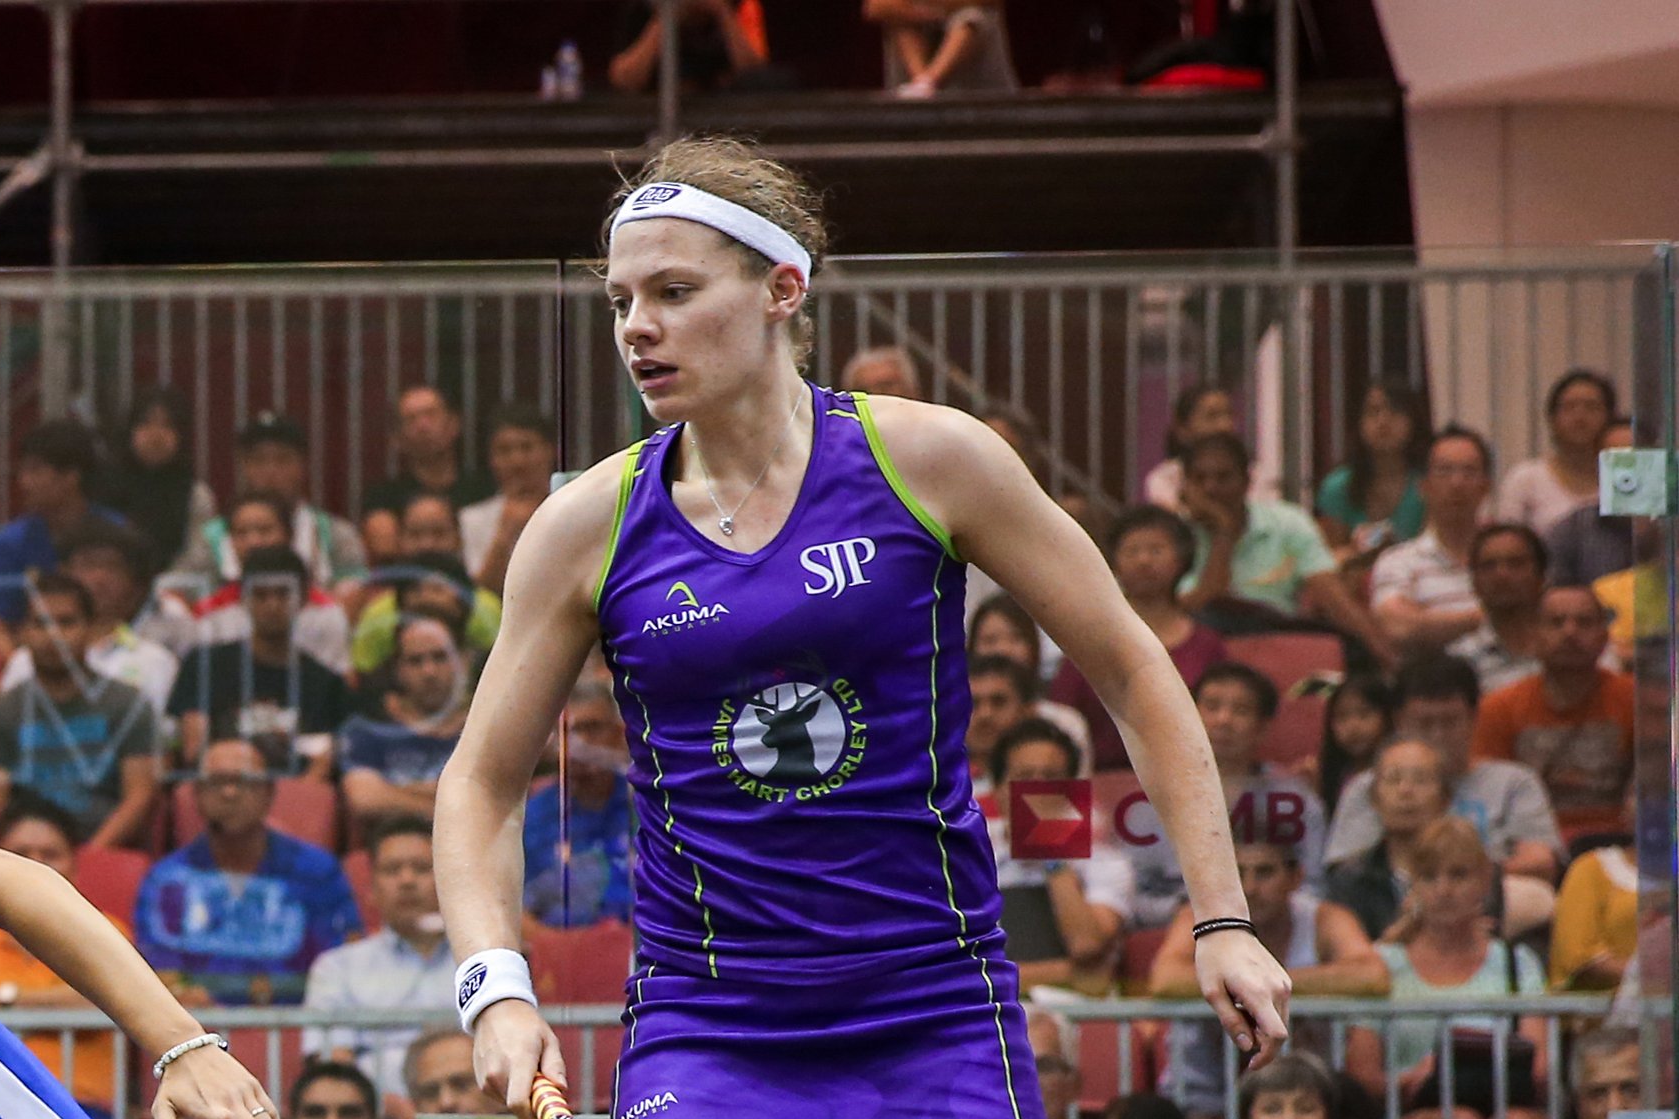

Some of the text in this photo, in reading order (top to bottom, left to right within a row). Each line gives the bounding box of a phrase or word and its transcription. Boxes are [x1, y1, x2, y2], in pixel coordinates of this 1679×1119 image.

[799, 537, 877, 599] SJP
[641, 602, 731, 634] AKUMA
[650, 615, 721, 638] SQUASH
[711, 678, 868, 803] JAMES HART CHORLEY LTD
